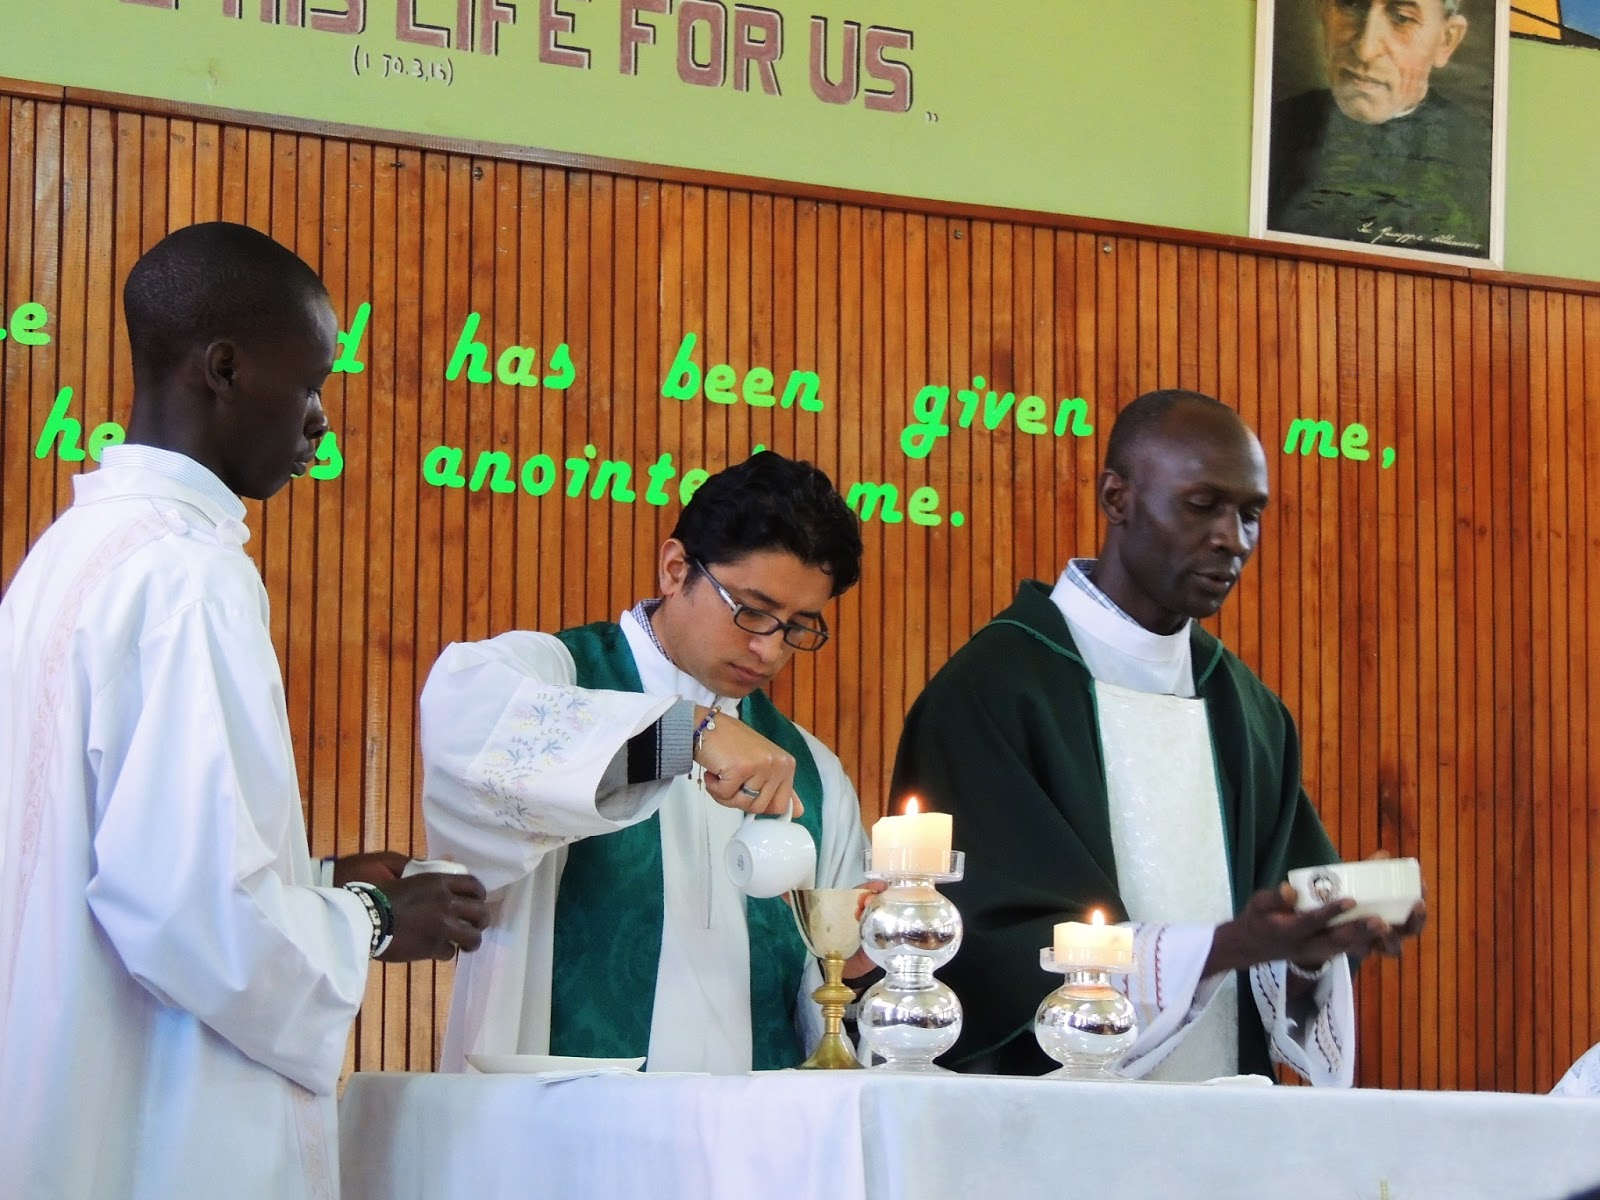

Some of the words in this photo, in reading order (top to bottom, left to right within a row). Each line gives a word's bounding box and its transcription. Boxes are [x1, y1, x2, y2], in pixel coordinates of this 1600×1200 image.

[396, 0, 591, 70] LIFE
[619, 0, 784, 97] FOR
[34, 385, 126, 463] he
[422, 444, 767, 507] anointe
[845, 481, 965, 528] me.
[445, 311, 577, 391] has
[661, 331, 825, 413] been
[899, 375, 1094, 460] given
[1283, 418, 1396, 469] me,
